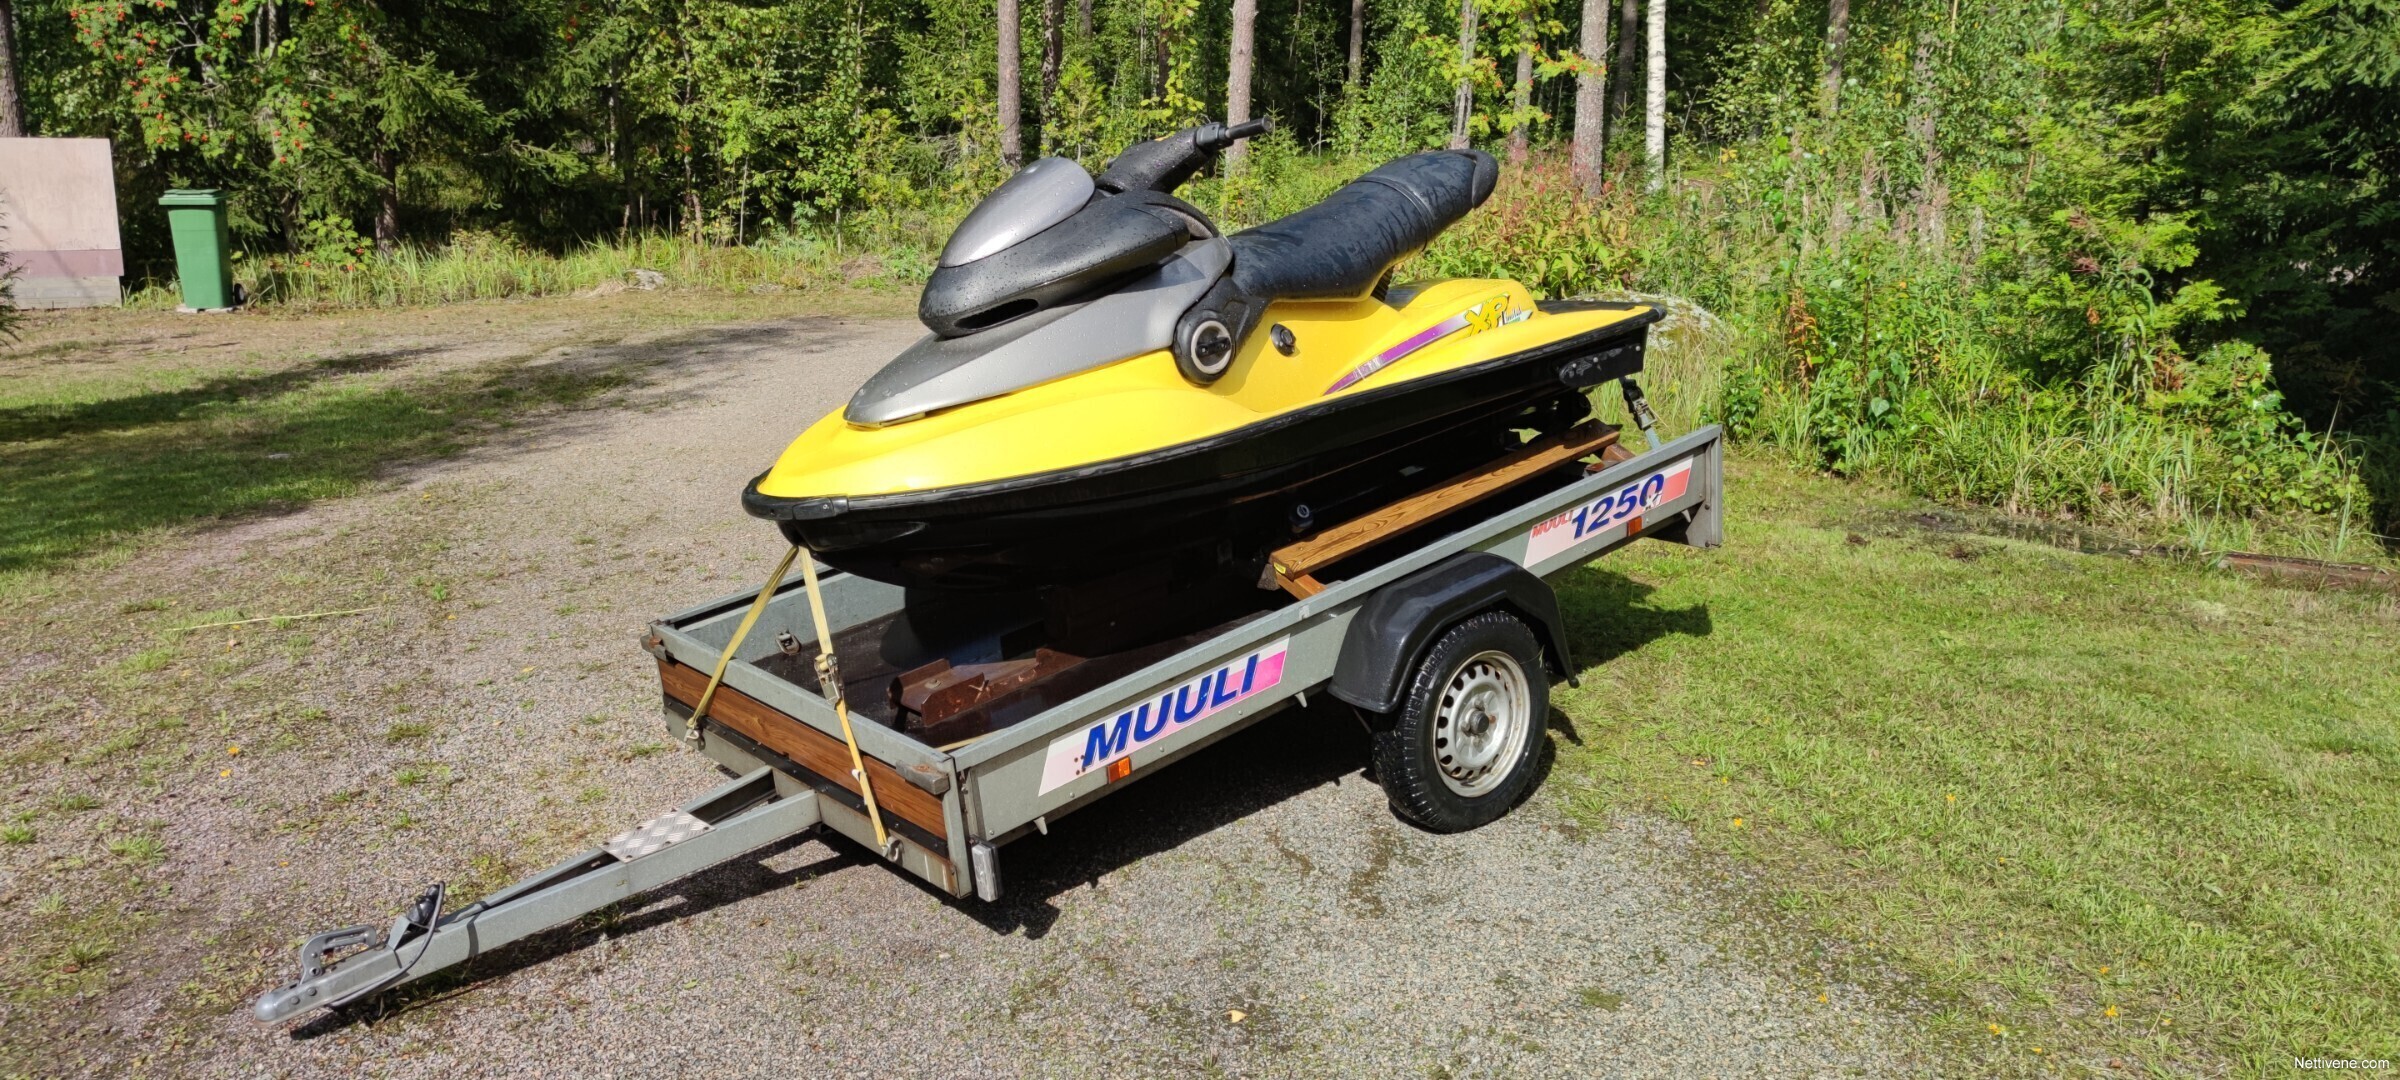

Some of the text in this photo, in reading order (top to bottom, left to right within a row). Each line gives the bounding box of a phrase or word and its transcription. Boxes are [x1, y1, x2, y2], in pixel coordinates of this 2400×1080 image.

[1465, 294, 1510, 336] XP
[1532, 510, 1573, 538] MUULI
[1572, 474, 1664, 539] 1250
[1082, 653, 1260, 769] MUULI
